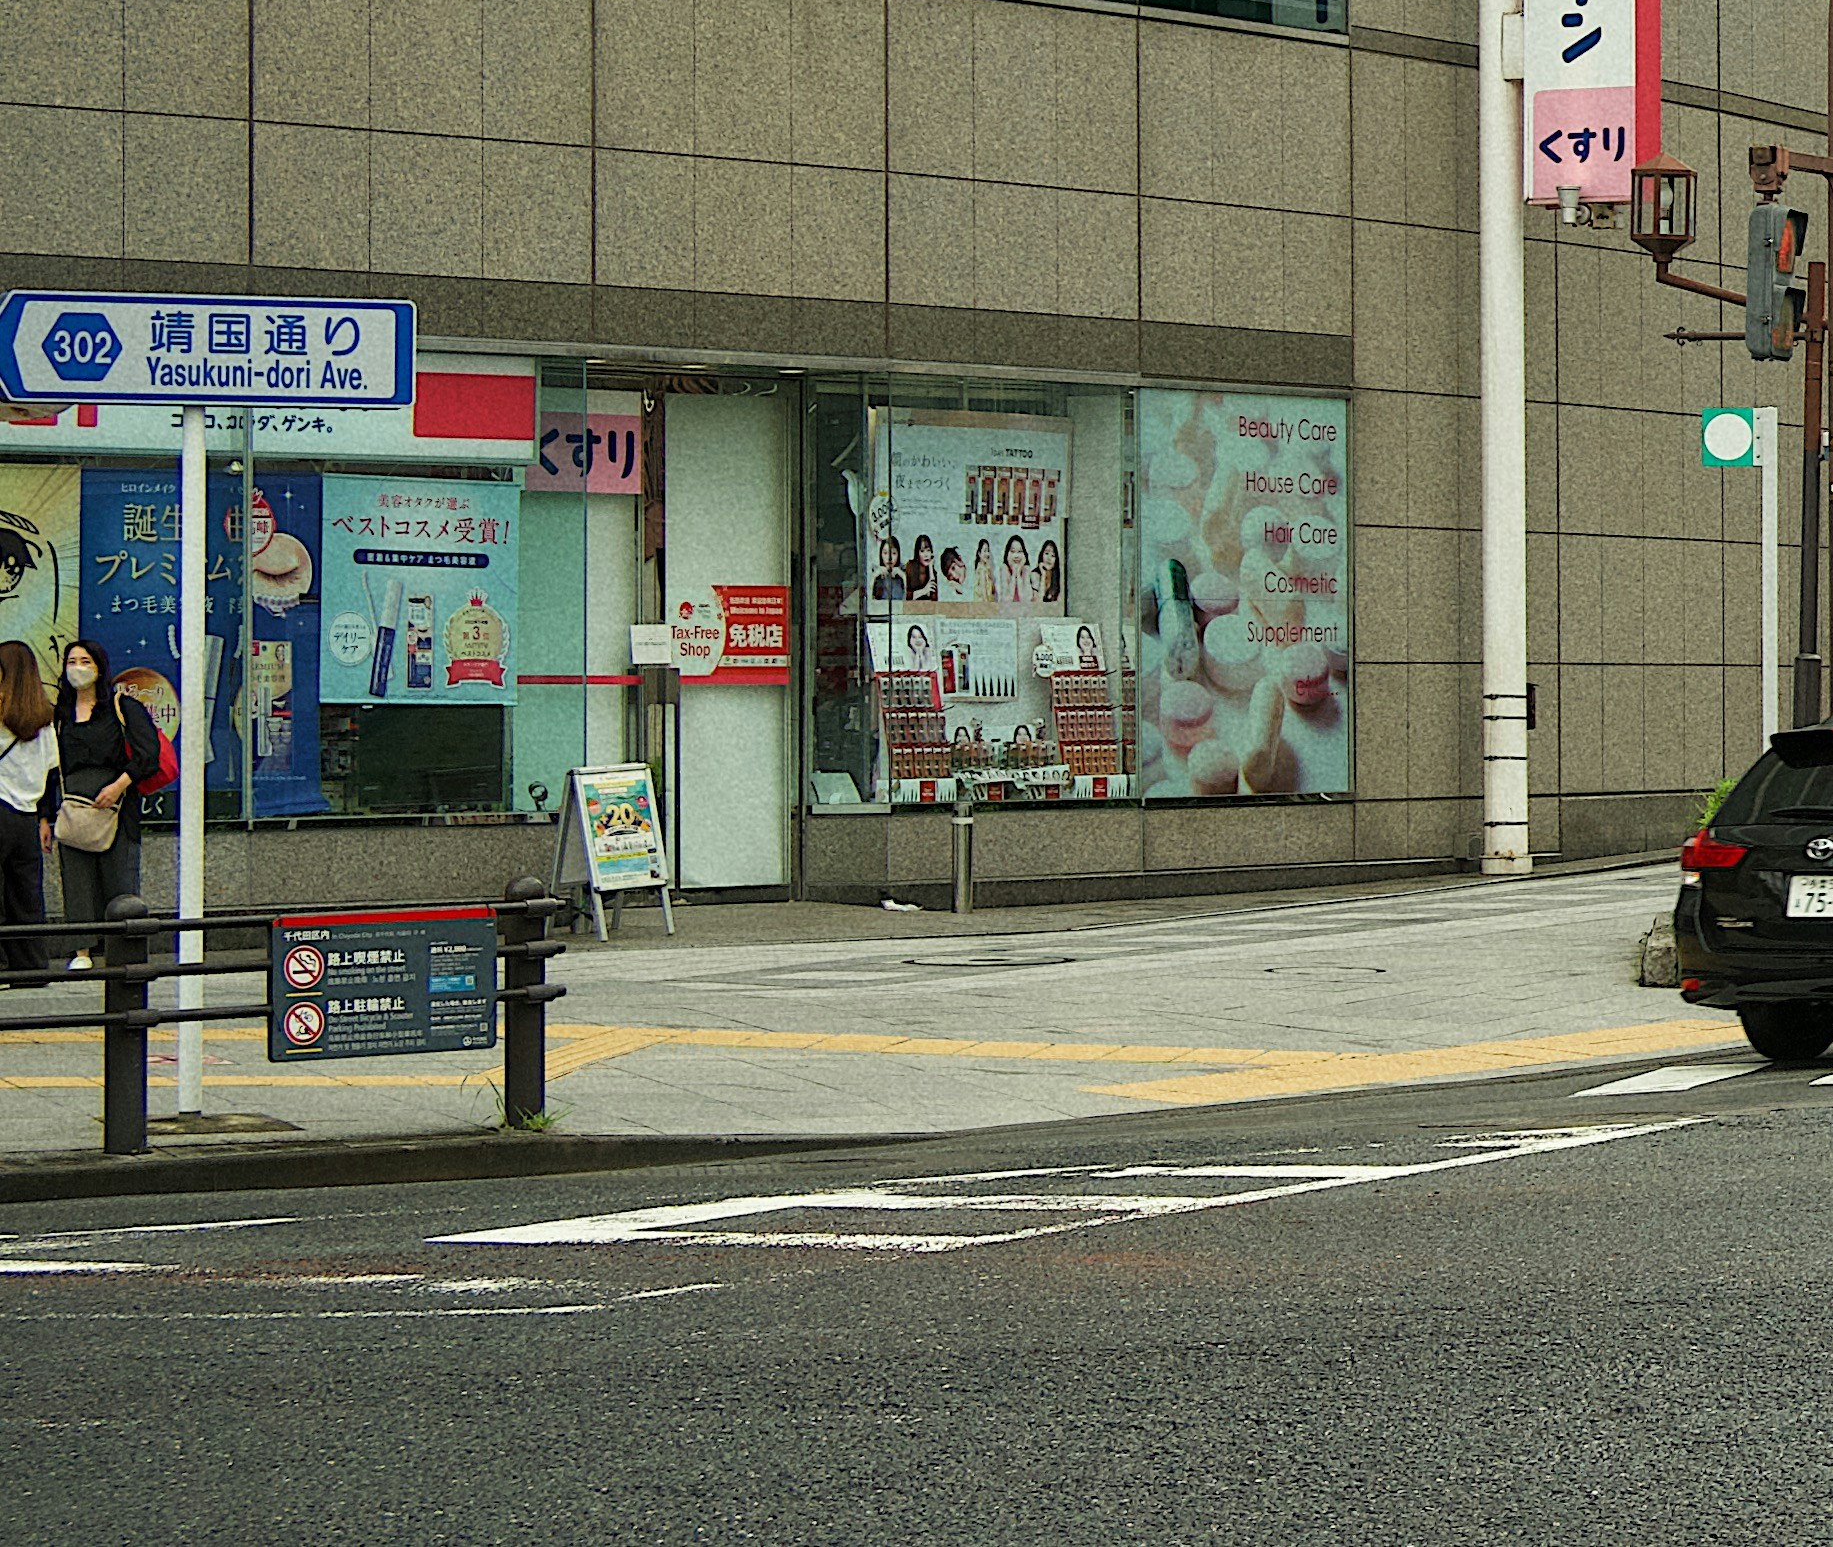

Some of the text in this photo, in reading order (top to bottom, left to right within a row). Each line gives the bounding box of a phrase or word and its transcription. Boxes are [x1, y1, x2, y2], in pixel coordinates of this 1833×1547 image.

[1538, 124, 1626, 165] くすり
[149, 310, 361, 356] 靖国通り
[53, 330, 112, 365] 302
[146, 356, 368, 391] Yasukuni-dori Ave.
[1238, 415, 1338, 444] Beauty Care
[540, 427, 635, 480] くすり
[1245, 470, 1338, 496] House Care
[1263, 521, 1338, 546] Hair Care
[1263, 571, 1338, 595] Cosmetic
[671, 625, 720, 640] Tax-Free
[729, 623, 784, 648] 免税店
[1247, 621, 1338, 649] Supplement
[680, 642, 711, 659] Shop
[283, 930, 330, 942] 千代田区内
[327, 949, 406, 967] 路上喫煙禁止
[327, 996, 406, 1014] 路上駐輪禁止
